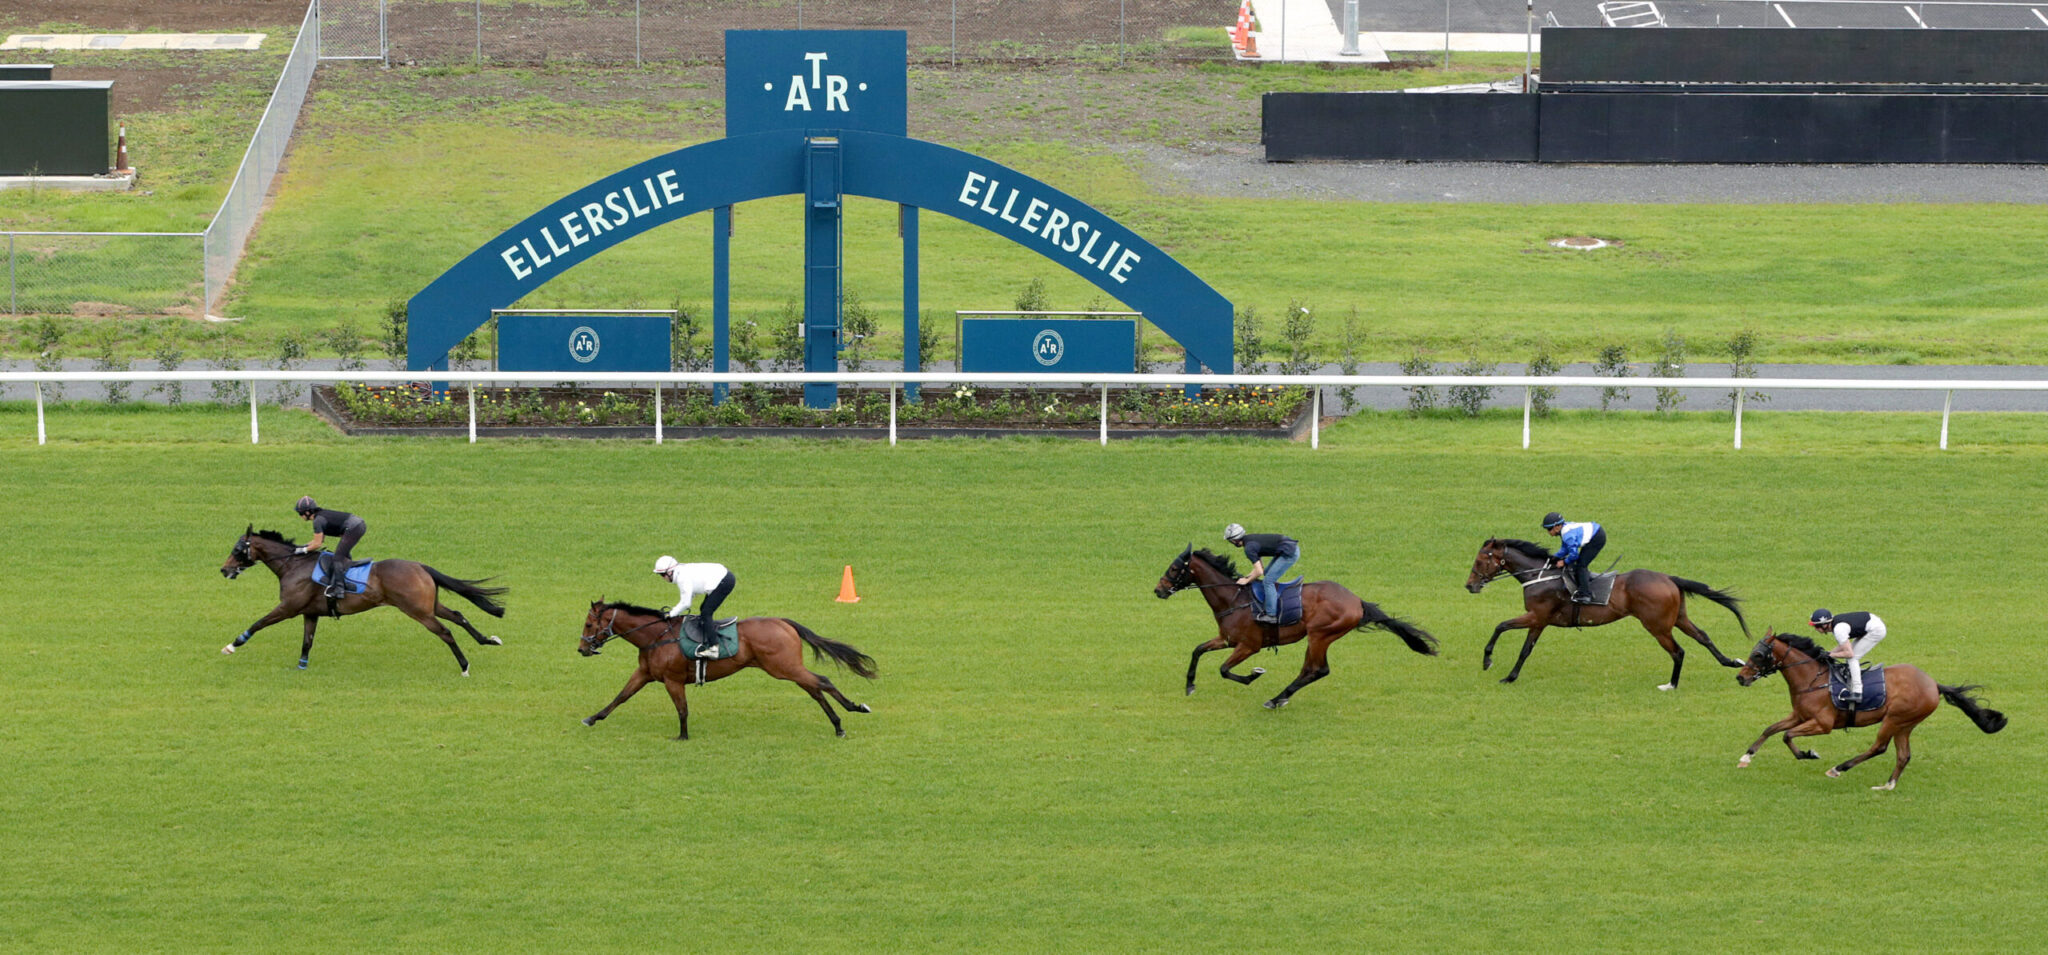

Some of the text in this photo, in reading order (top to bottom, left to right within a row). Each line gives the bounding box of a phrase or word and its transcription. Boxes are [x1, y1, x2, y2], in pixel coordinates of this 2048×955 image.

[784, 52, 850, 112] ATR
[501, 169, 685, 281] ELLERSLIE
[958, 171, 1141, 284] ELLERSLIE
[575, 335, 593, 351] ATR
[1040, 338, 1057, 354] ATR
